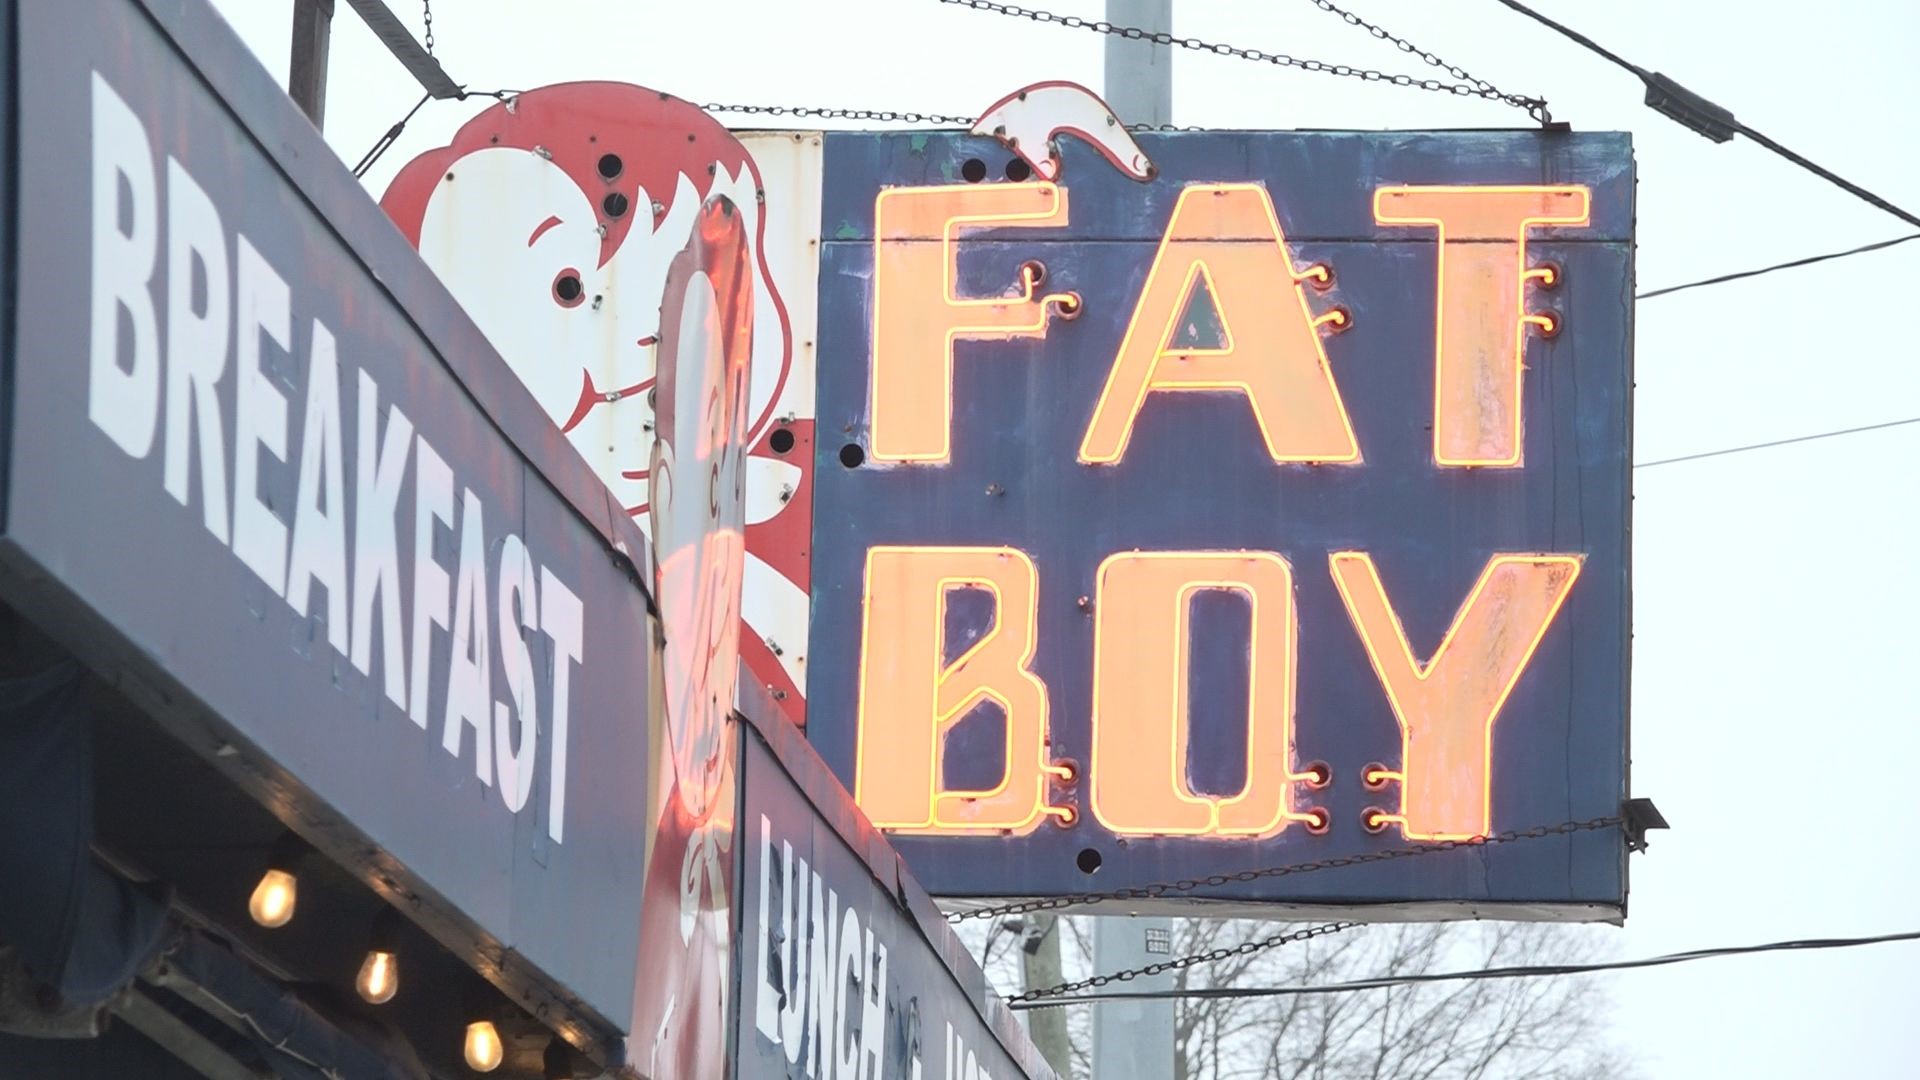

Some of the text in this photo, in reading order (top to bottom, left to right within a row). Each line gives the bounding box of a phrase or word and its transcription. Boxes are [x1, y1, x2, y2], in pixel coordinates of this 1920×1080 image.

[89, 70, 584, 845] BREAKFAST
[868, 181, 1591, 468] FAT
[854, 545, 1588, 842] BOY
[756, 813, 888, 1080] LUNCH
